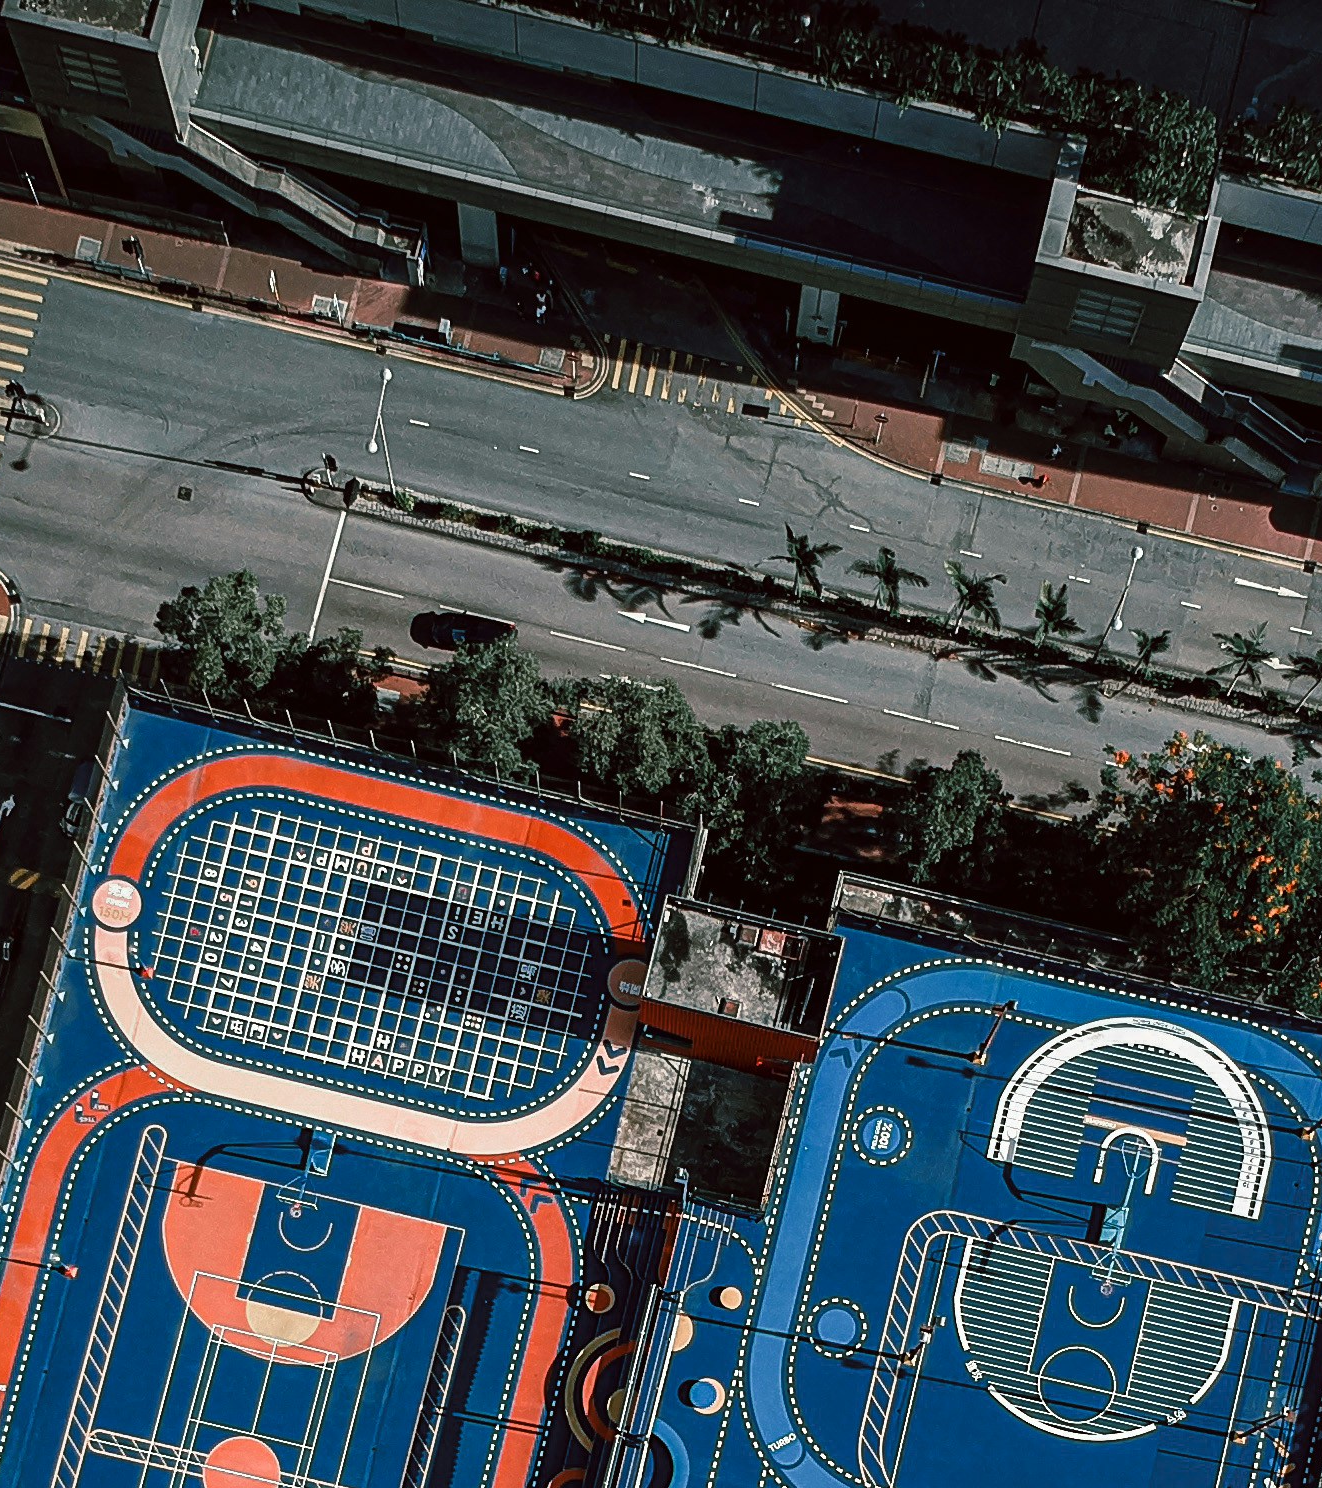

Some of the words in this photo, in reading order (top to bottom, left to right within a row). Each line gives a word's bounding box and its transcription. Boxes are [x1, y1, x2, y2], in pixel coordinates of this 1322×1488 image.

[204, 867, 217, 879] 8
[220, 892, 233, 903] 5
[235, 918, 248, 928] 3
[209, 932, 223, 943] 2
[250, 942, 264, 953] 4
[221, 977, 234, 989] 7
[230, 1020, 266, 1039] 屯門
[351, 1049, 446, 1083] HAPPY
[878, 1122, 893, 1149] 100%
[767, 1432, 797, 1452] TURBO
